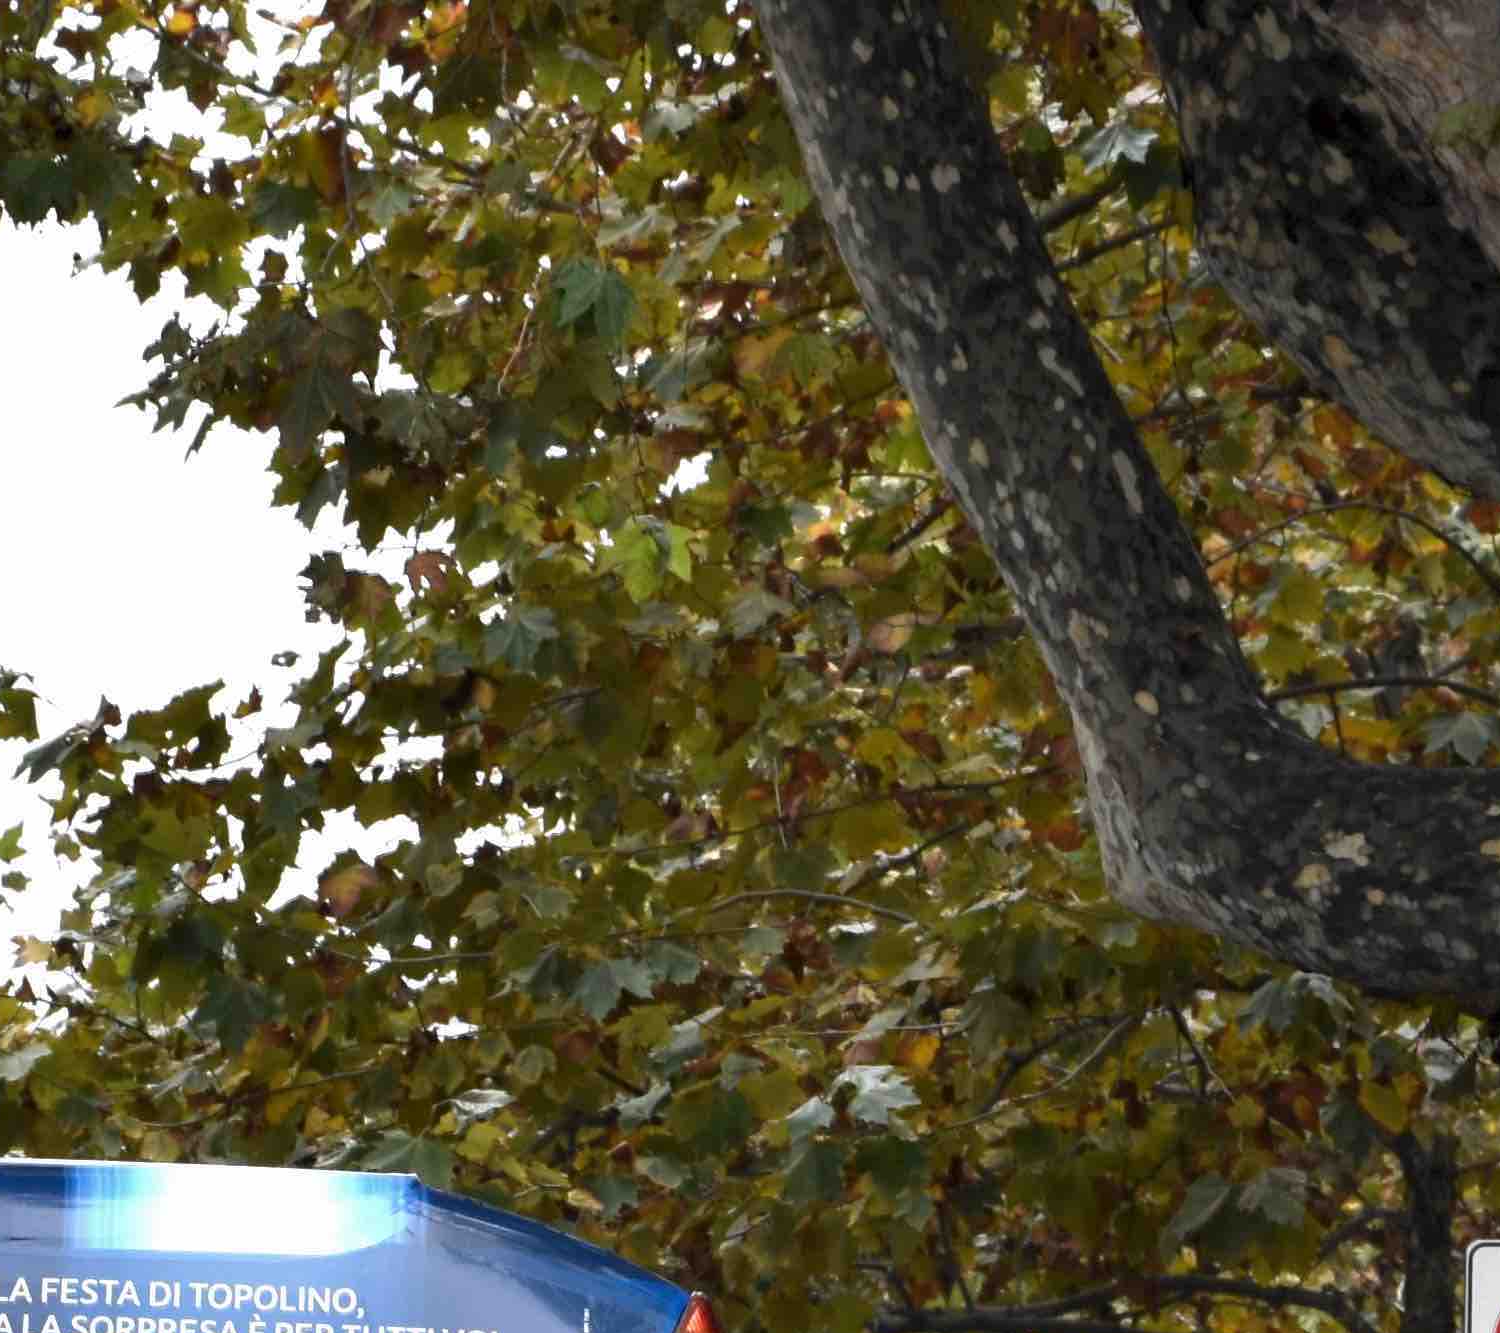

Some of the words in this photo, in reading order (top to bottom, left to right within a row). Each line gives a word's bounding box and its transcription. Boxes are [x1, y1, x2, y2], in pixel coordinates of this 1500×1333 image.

[41, 1278, 142, 1307] FESTA
[148, 1281, 180, 1308] DI
[189, 1282, 365, 1318] TOPOLINO,
